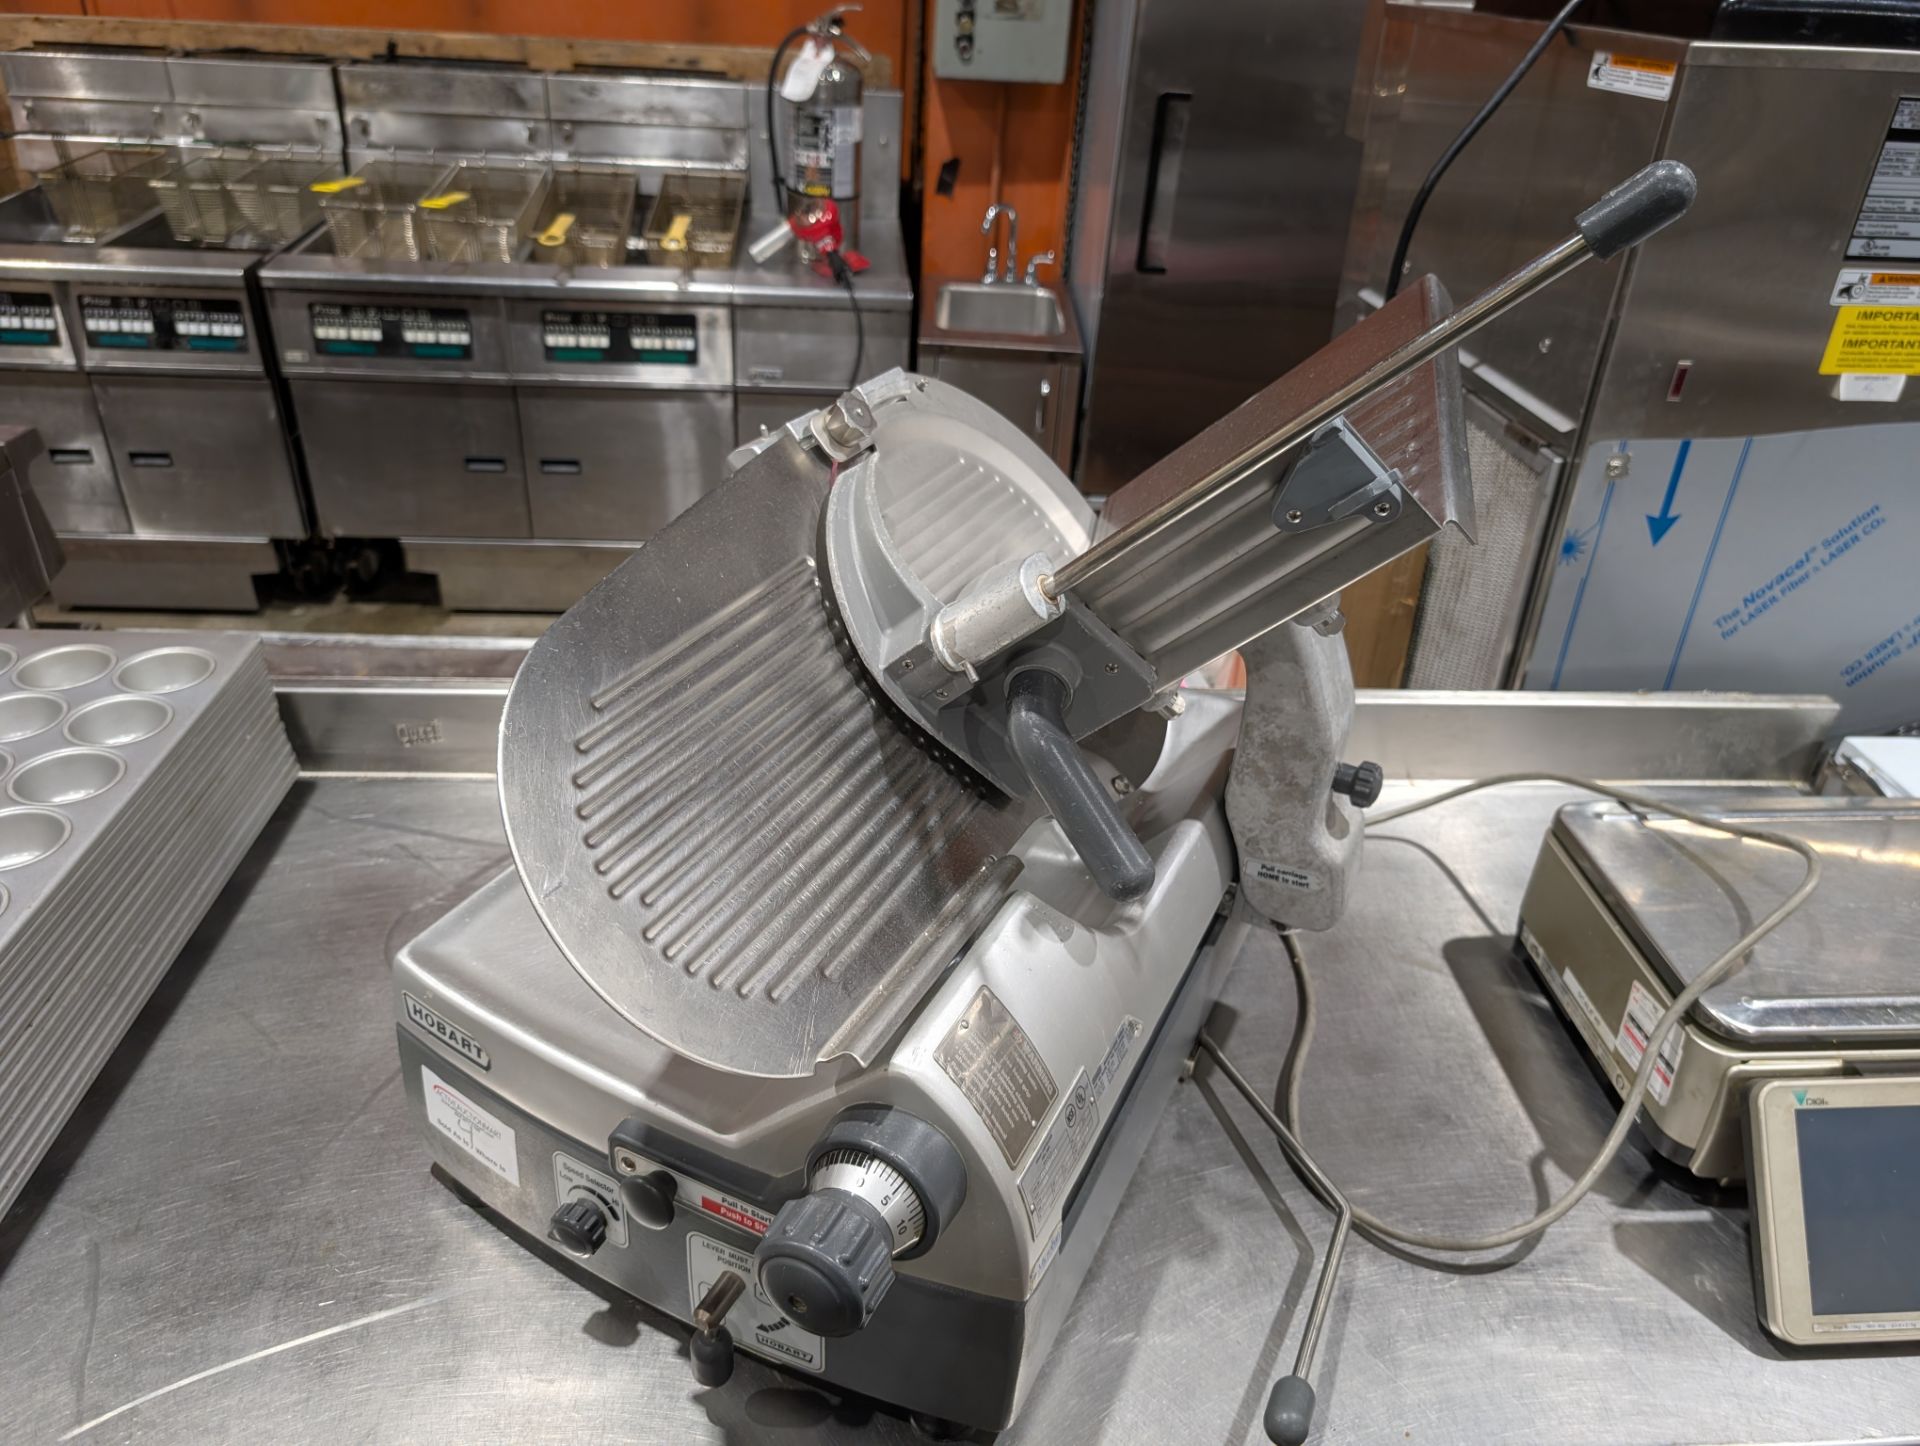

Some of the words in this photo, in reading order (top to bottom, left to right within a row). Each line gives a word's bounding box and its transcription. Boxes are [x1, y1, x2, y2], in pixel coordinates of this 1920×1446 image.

[1713, 607, 1741, 629] The
[1821, 504, 1881, 550] Solution
[1720, 624, 1740, 641] for
[1740, 595, 1779, 627] LASER
[1779, 570, 1811, 597] Fiber
[1820, 533, 1862, 568] LASER
[1257, 871, 1280, 881] HOME
[1292, 879, 1310, 889] start
[1261, 863, 1276, 873] Pull
[1276, 869, 1309, 881] carriage
[412, 1003, 483, 1060] HOBART
[562, 1162, 585, 1179] Speed
[585, 1174, 614, 1193] Selector
[721, 1196, 738, 1209] Pull
[740, 1205, 749, 1214] to
[751, 1209, 772, 1224] Start
[880, 1194, 892, 1206] 5
[720, 1206, 742, 1222] Push
[743, 1217, 753, 1227] to
[896, 1218, 908, 1236] 10
[702, 1240, 726, 1256] LEVER
[728, 1251, 749, 1265] MUST
[717, 1255, 752, 1274] POSITION
[761, 1336, 808, 1359] HOBART
